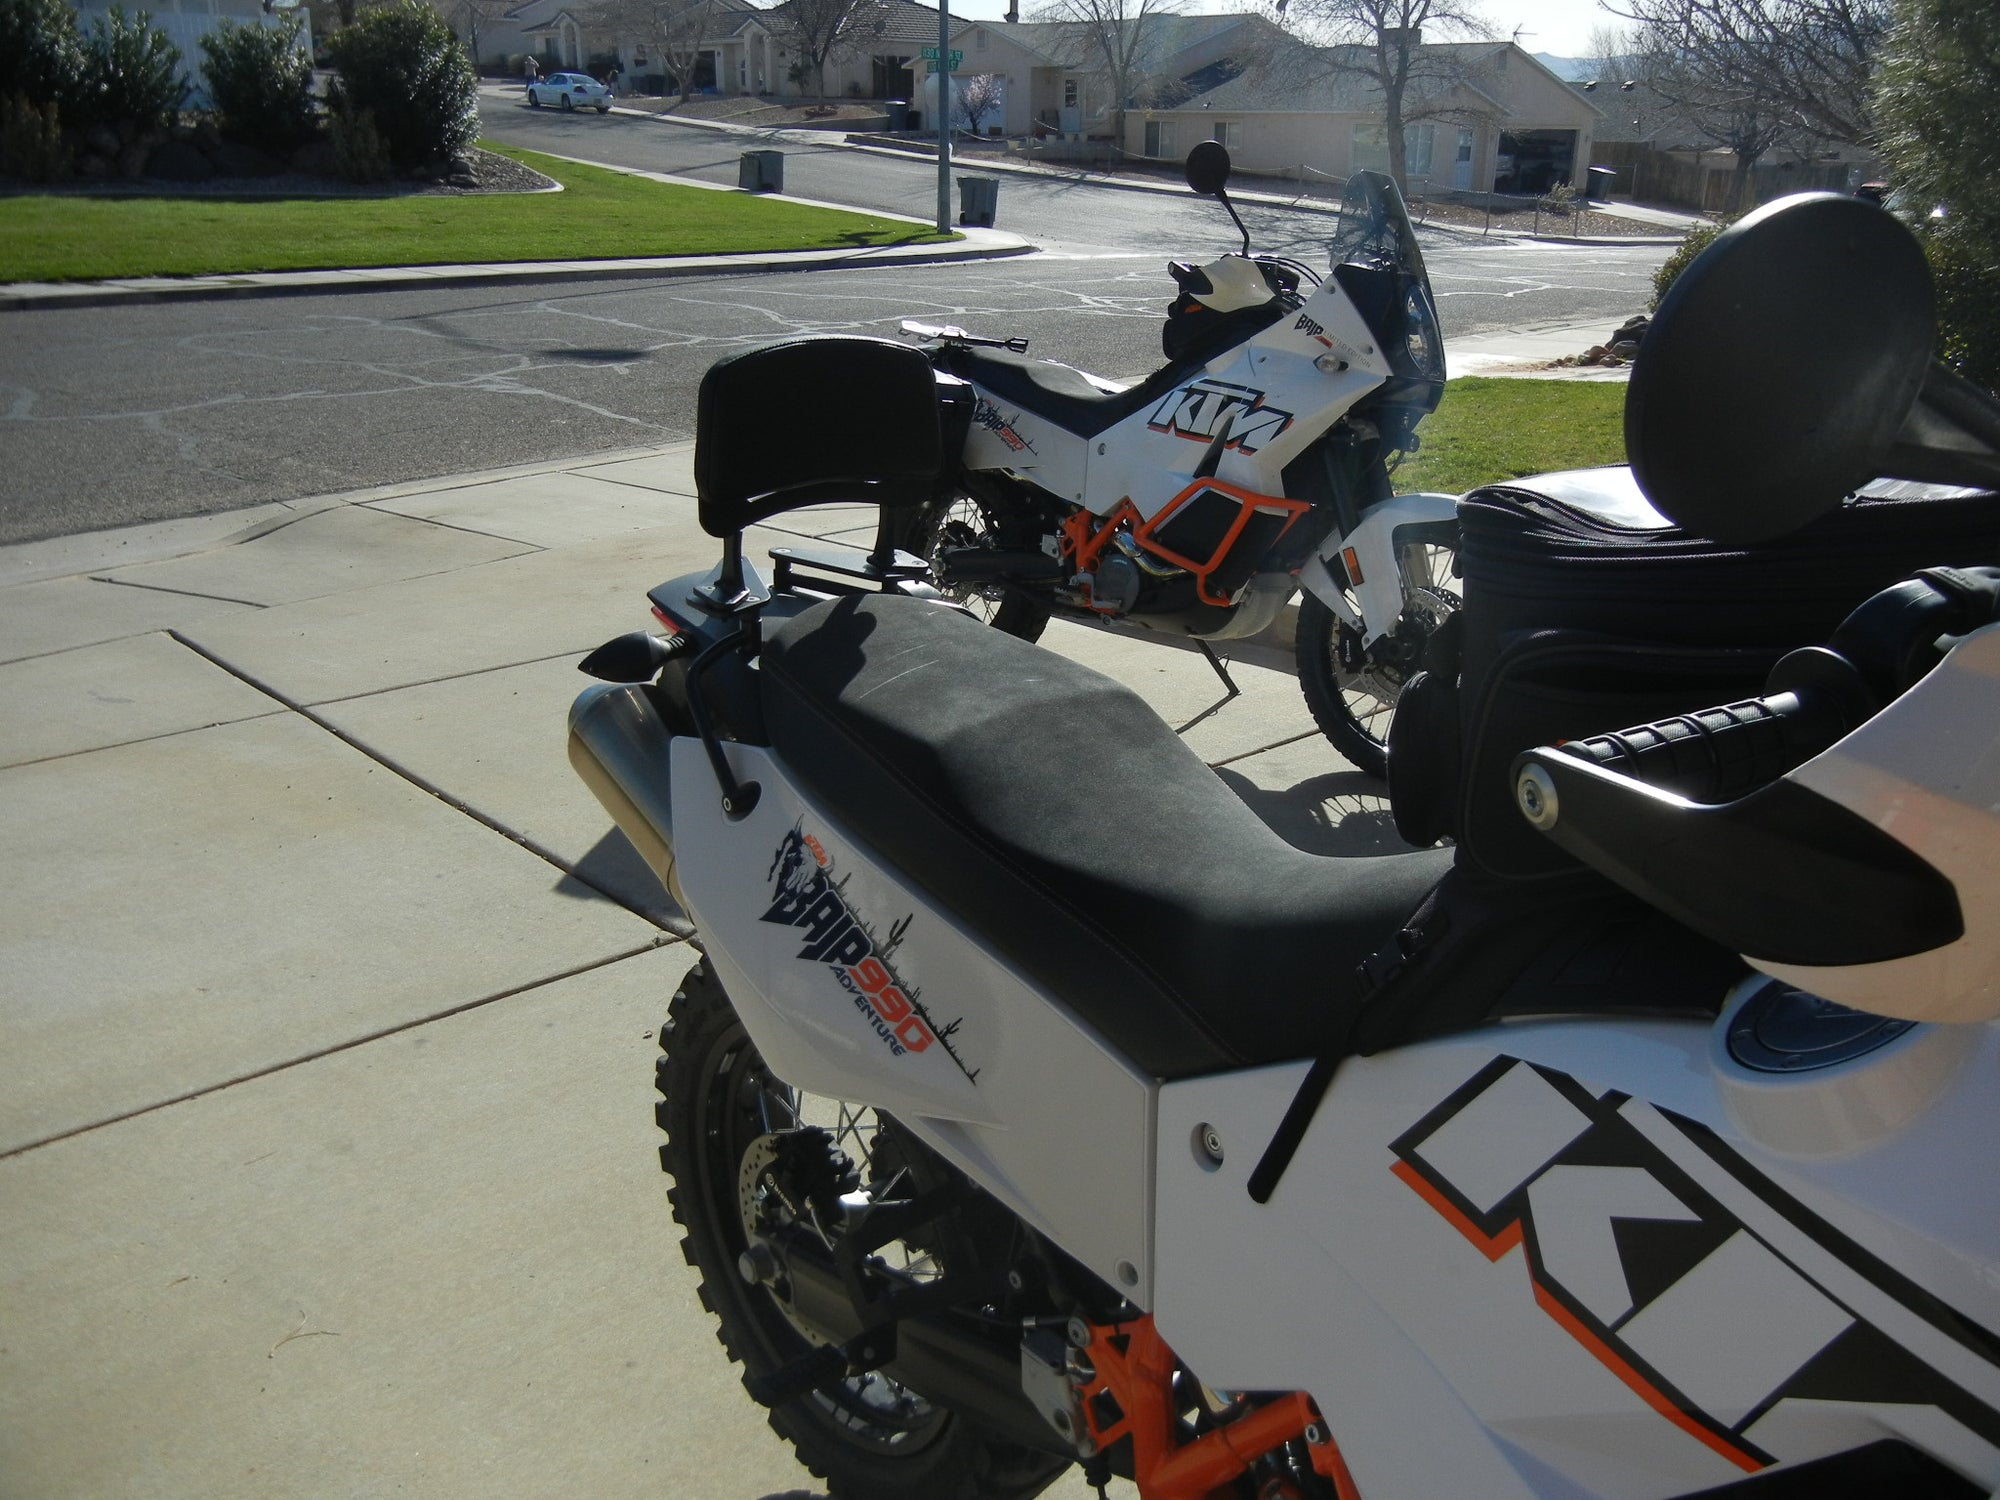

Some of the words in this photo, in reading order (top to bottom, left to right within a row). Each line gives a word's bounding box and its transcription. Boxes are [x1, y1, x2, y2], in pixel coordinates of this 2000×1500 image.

[1147, 378, 1294, 456] KTM
[828, 964, 907, 1056] ADVENTURE
[848, 955, 935, 1053] 990
[1387, 1053, 2000, 1474] KT
